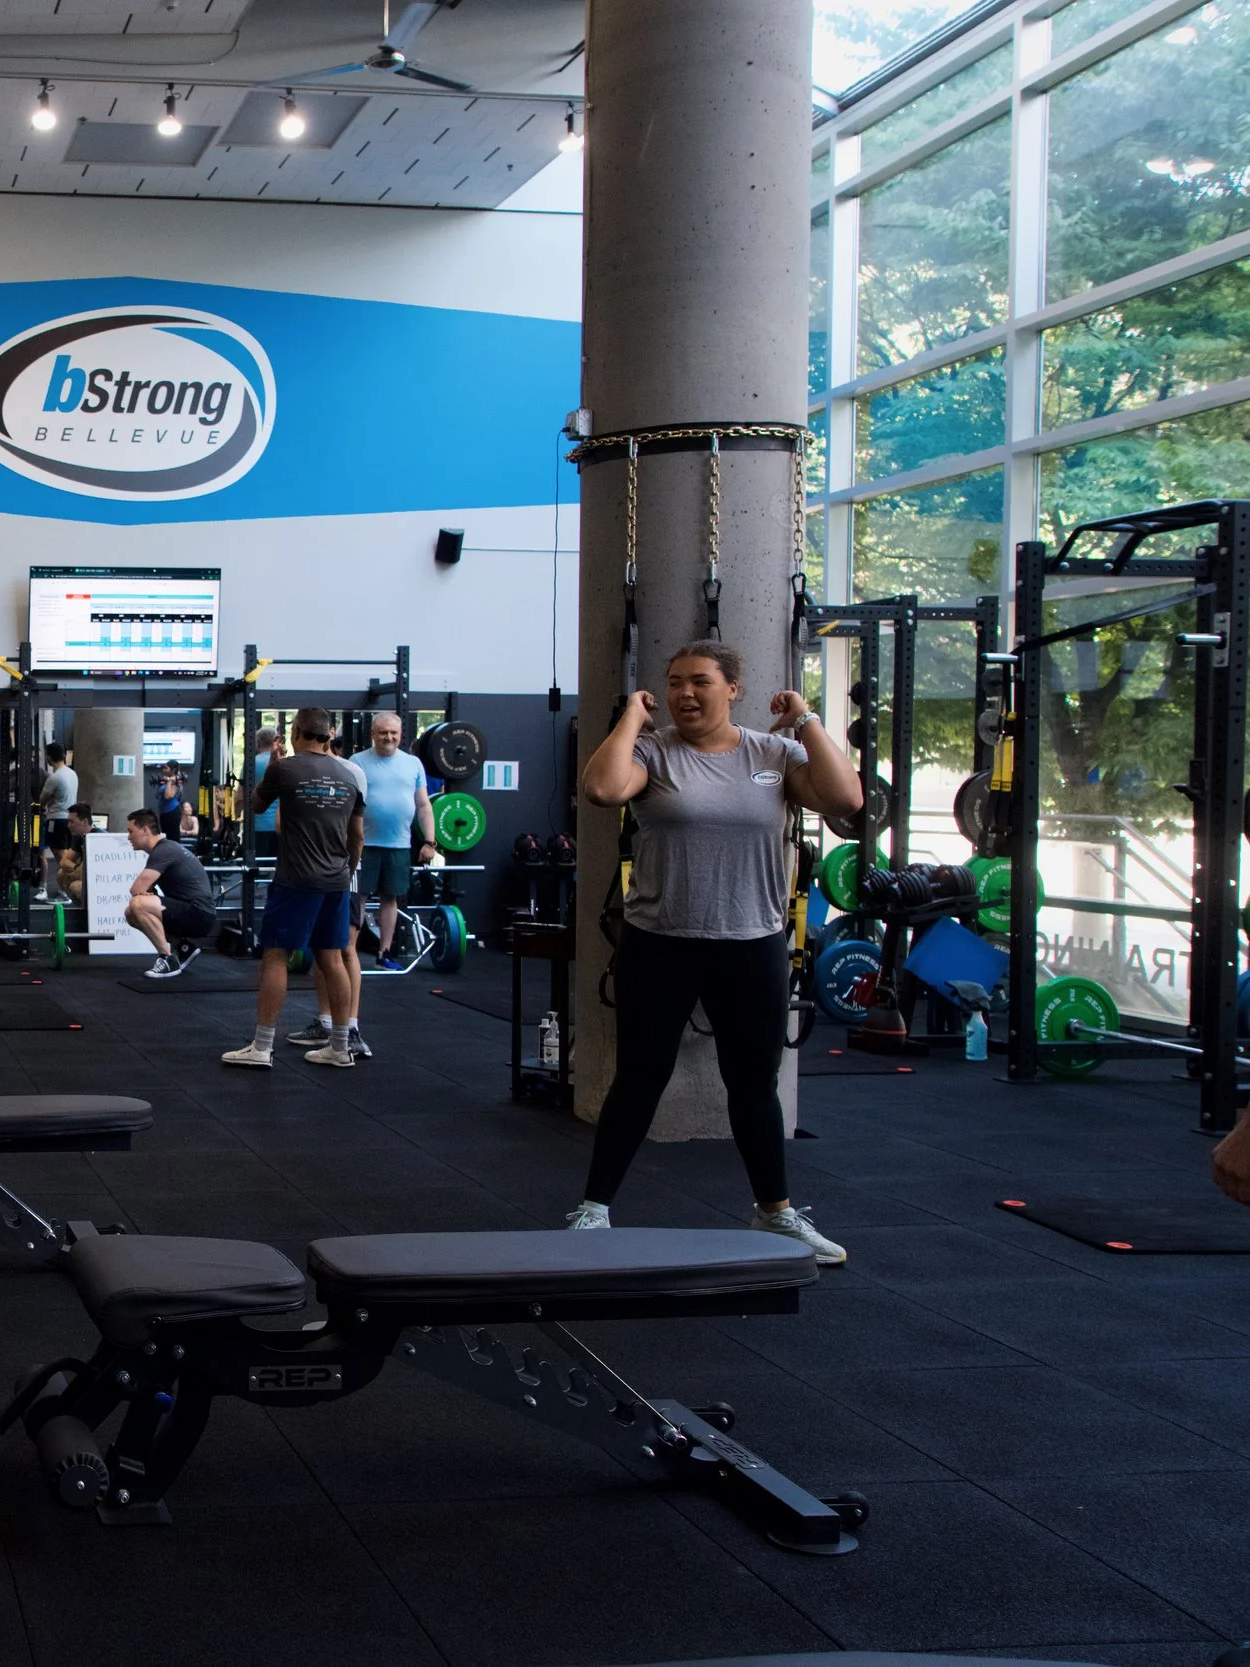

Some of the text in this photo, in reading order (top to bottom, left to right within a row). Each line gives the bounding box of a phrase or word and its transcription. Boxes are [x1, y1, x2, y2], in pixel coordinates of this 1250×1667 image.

[42, 355, 232, 426] bStrong
[35, 427, 220, 445] BELLEVUE
[94, 851, 138, 863] DEADLIFT
[258, 1368, 332, 1388] REP
